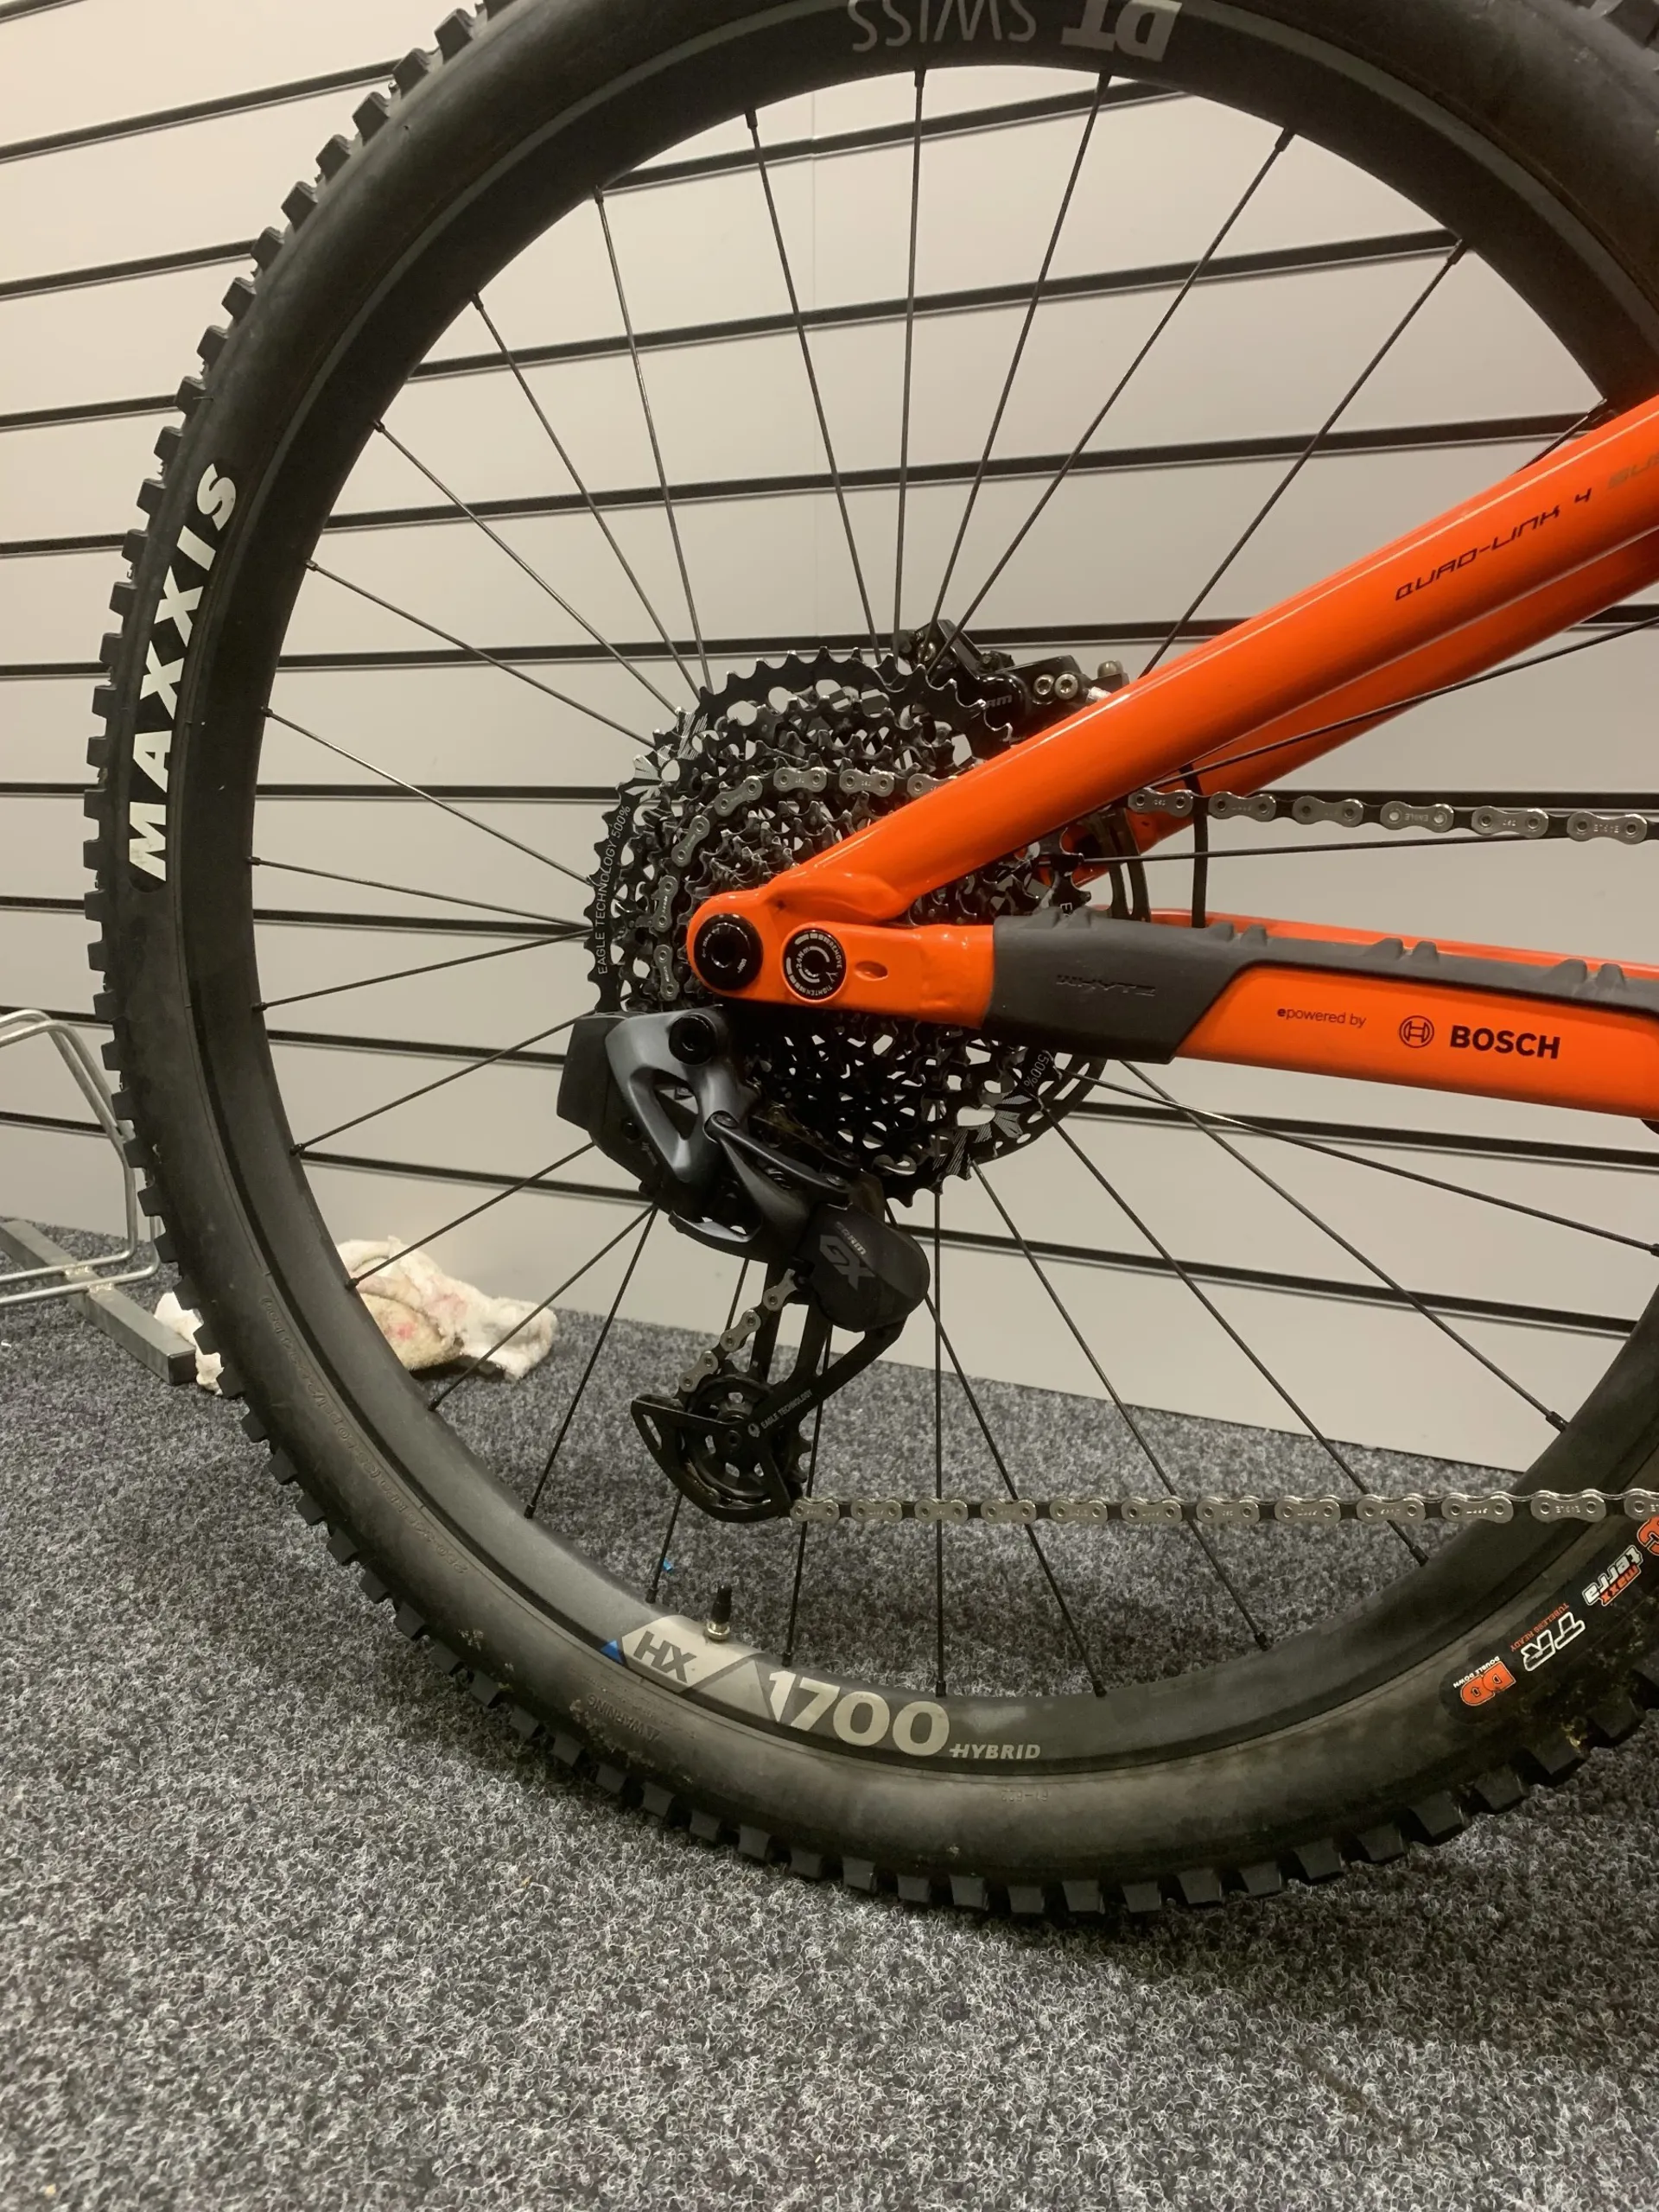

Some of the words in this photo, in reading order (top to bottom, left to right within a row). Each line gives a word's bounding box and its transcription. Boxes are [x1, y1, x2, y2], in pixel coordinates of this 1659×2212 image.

[847, 0, 1036, 52] SWISS
[1061, 0, 1182, 61] DT
[1395, 505, 1560, 601] QUAD-LINK
[1574, 487, 1592, 504] 4
[129, 463, 236, 881] MAXXIS
[611, 805, 631, 838] 500%
[595, 842, 617, 928] TECHNOLOGY
[595, 931, 608, 975] EAGLE
[1277, 1007, 1345, 1025] epowered
[1350, 1012, 1366, 1028] by
[1450, 1025, 1560, 1059] BOSCH
[1024, 1052, 1050, 1088] 500%
[819, 1235, 876, 1291] GX
[1510, 1629, 1535, 1652] READY
[1520, 1611, 1586, 1671] TR
[1533, 1601, 1570, 1634] TUBELESS
[632, 1631, 697, 1684] HX
[1453, 1669, 1477, 1688] DOWN
[1476, 1656, 1500, 1675] DOUBLE
[768, 1670, 950, 1756] 1700
[950, 1743, 1041, 1760] HYBRID
